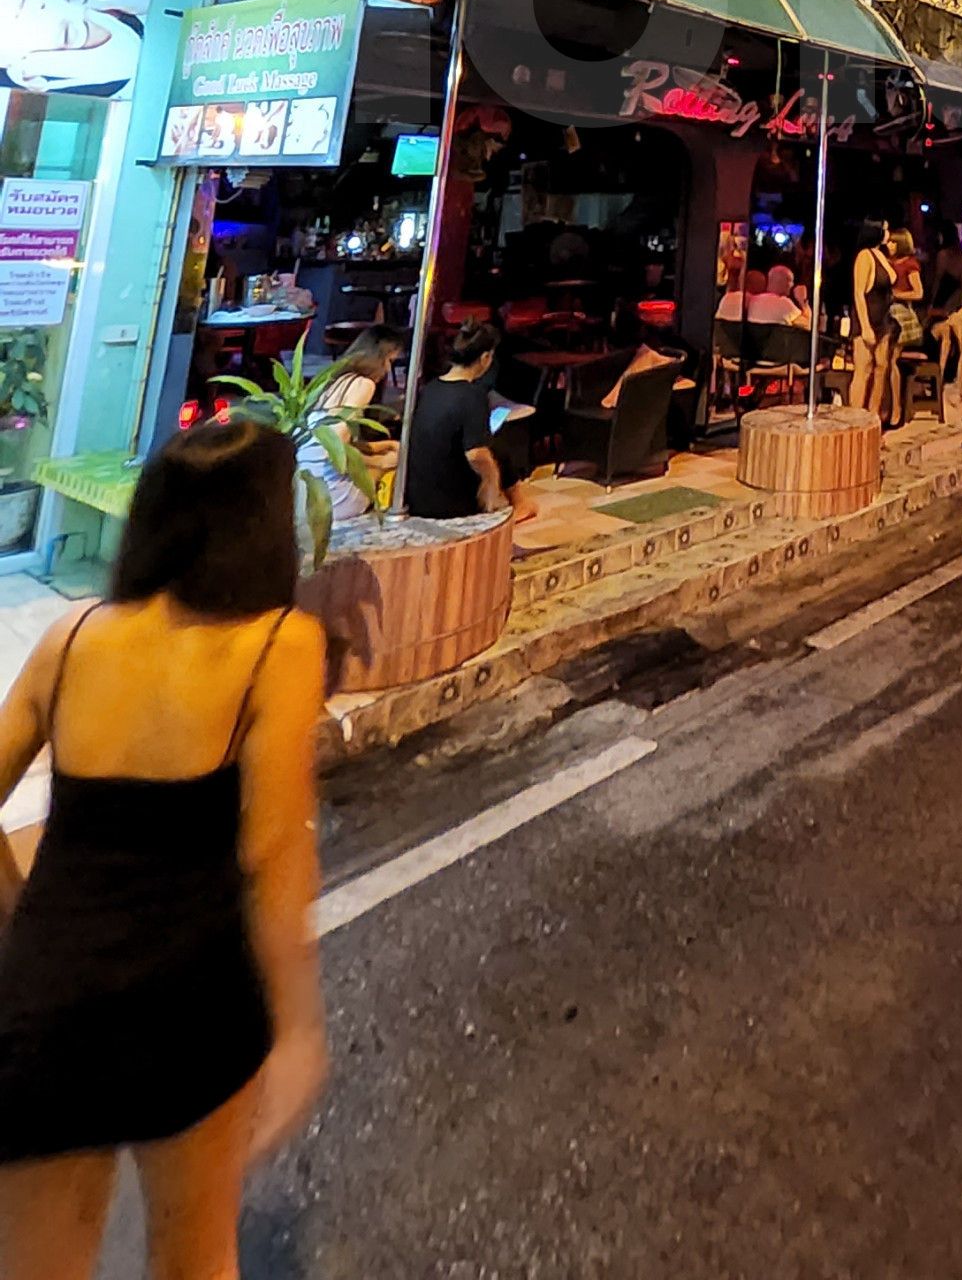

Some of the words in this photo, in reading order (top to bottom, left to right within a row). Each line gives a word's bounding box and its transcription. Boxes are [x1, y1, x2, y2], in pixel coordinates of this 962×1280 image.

[259, 70, 318, 96] Massage
[8, 189, 79, 203] รับสมัคร
